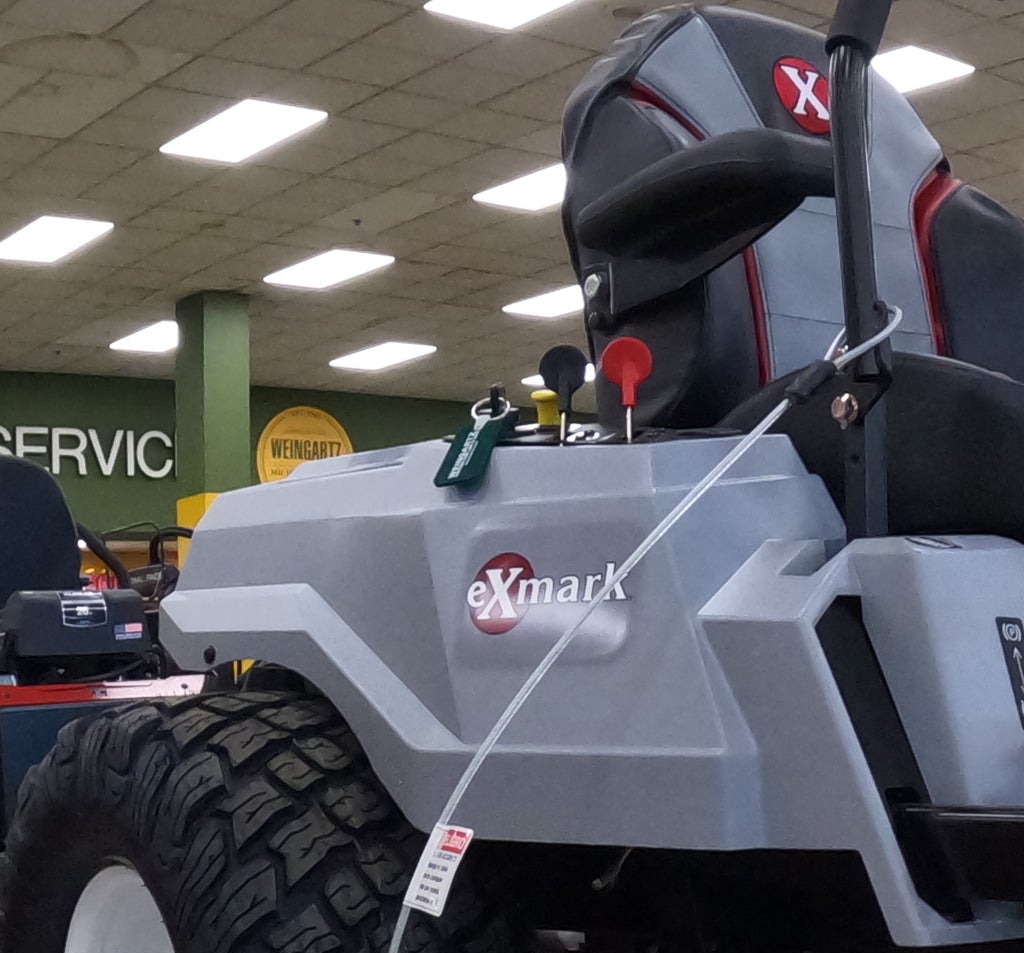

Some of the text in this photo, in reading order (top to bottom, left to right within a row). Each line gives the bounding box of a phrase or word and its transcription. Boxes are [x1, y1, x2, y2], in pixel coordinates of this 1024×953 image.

[780, 65, 830, 120] X
[0, 425, 177, 478] ERVIC
[467, 562, 629, 620] eXmark
